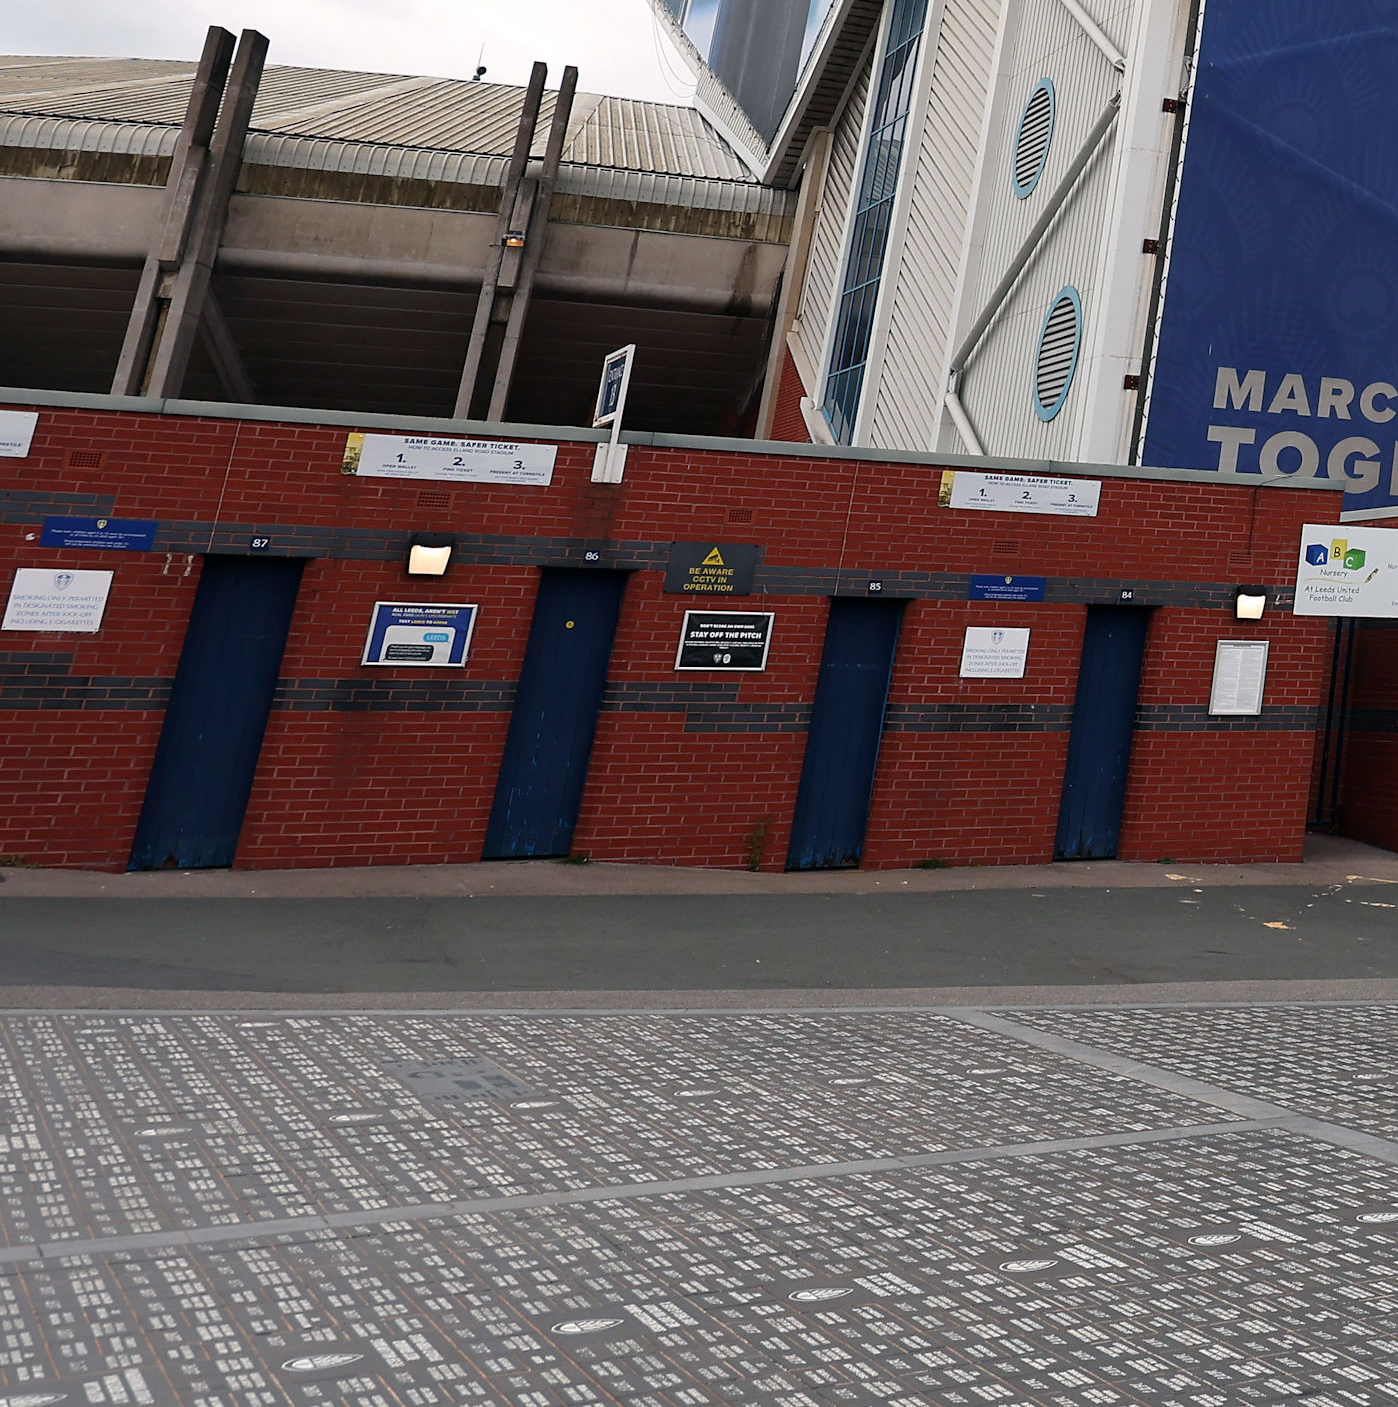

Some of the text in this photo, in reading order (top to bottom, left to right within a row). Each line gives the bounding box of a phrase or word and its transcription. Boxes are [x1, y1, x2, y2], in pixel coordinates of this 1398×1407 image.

[460, 440, 487, 449] SAFER
[452, 456, 466, 467] 2.
[513, 460, 525, 470] 3.
[252, 538, 269, 548] 87
[585, 551, 599, 561] 86
[689, 567, 734, 576] BE AWARE
[1320, 569, 1348, 578] Nursery
[692, 575, 717, 583] CCTV
[683, 583, 734, 591] OPERATION
[870, 582, 882, 591] 85
[1304, 585, 1360, 594] At Leeds United
[1121, 591, 1132, 599] 84
[1309, 594, 1337, 602] Football
[709, 631, 724, 639] OFF
